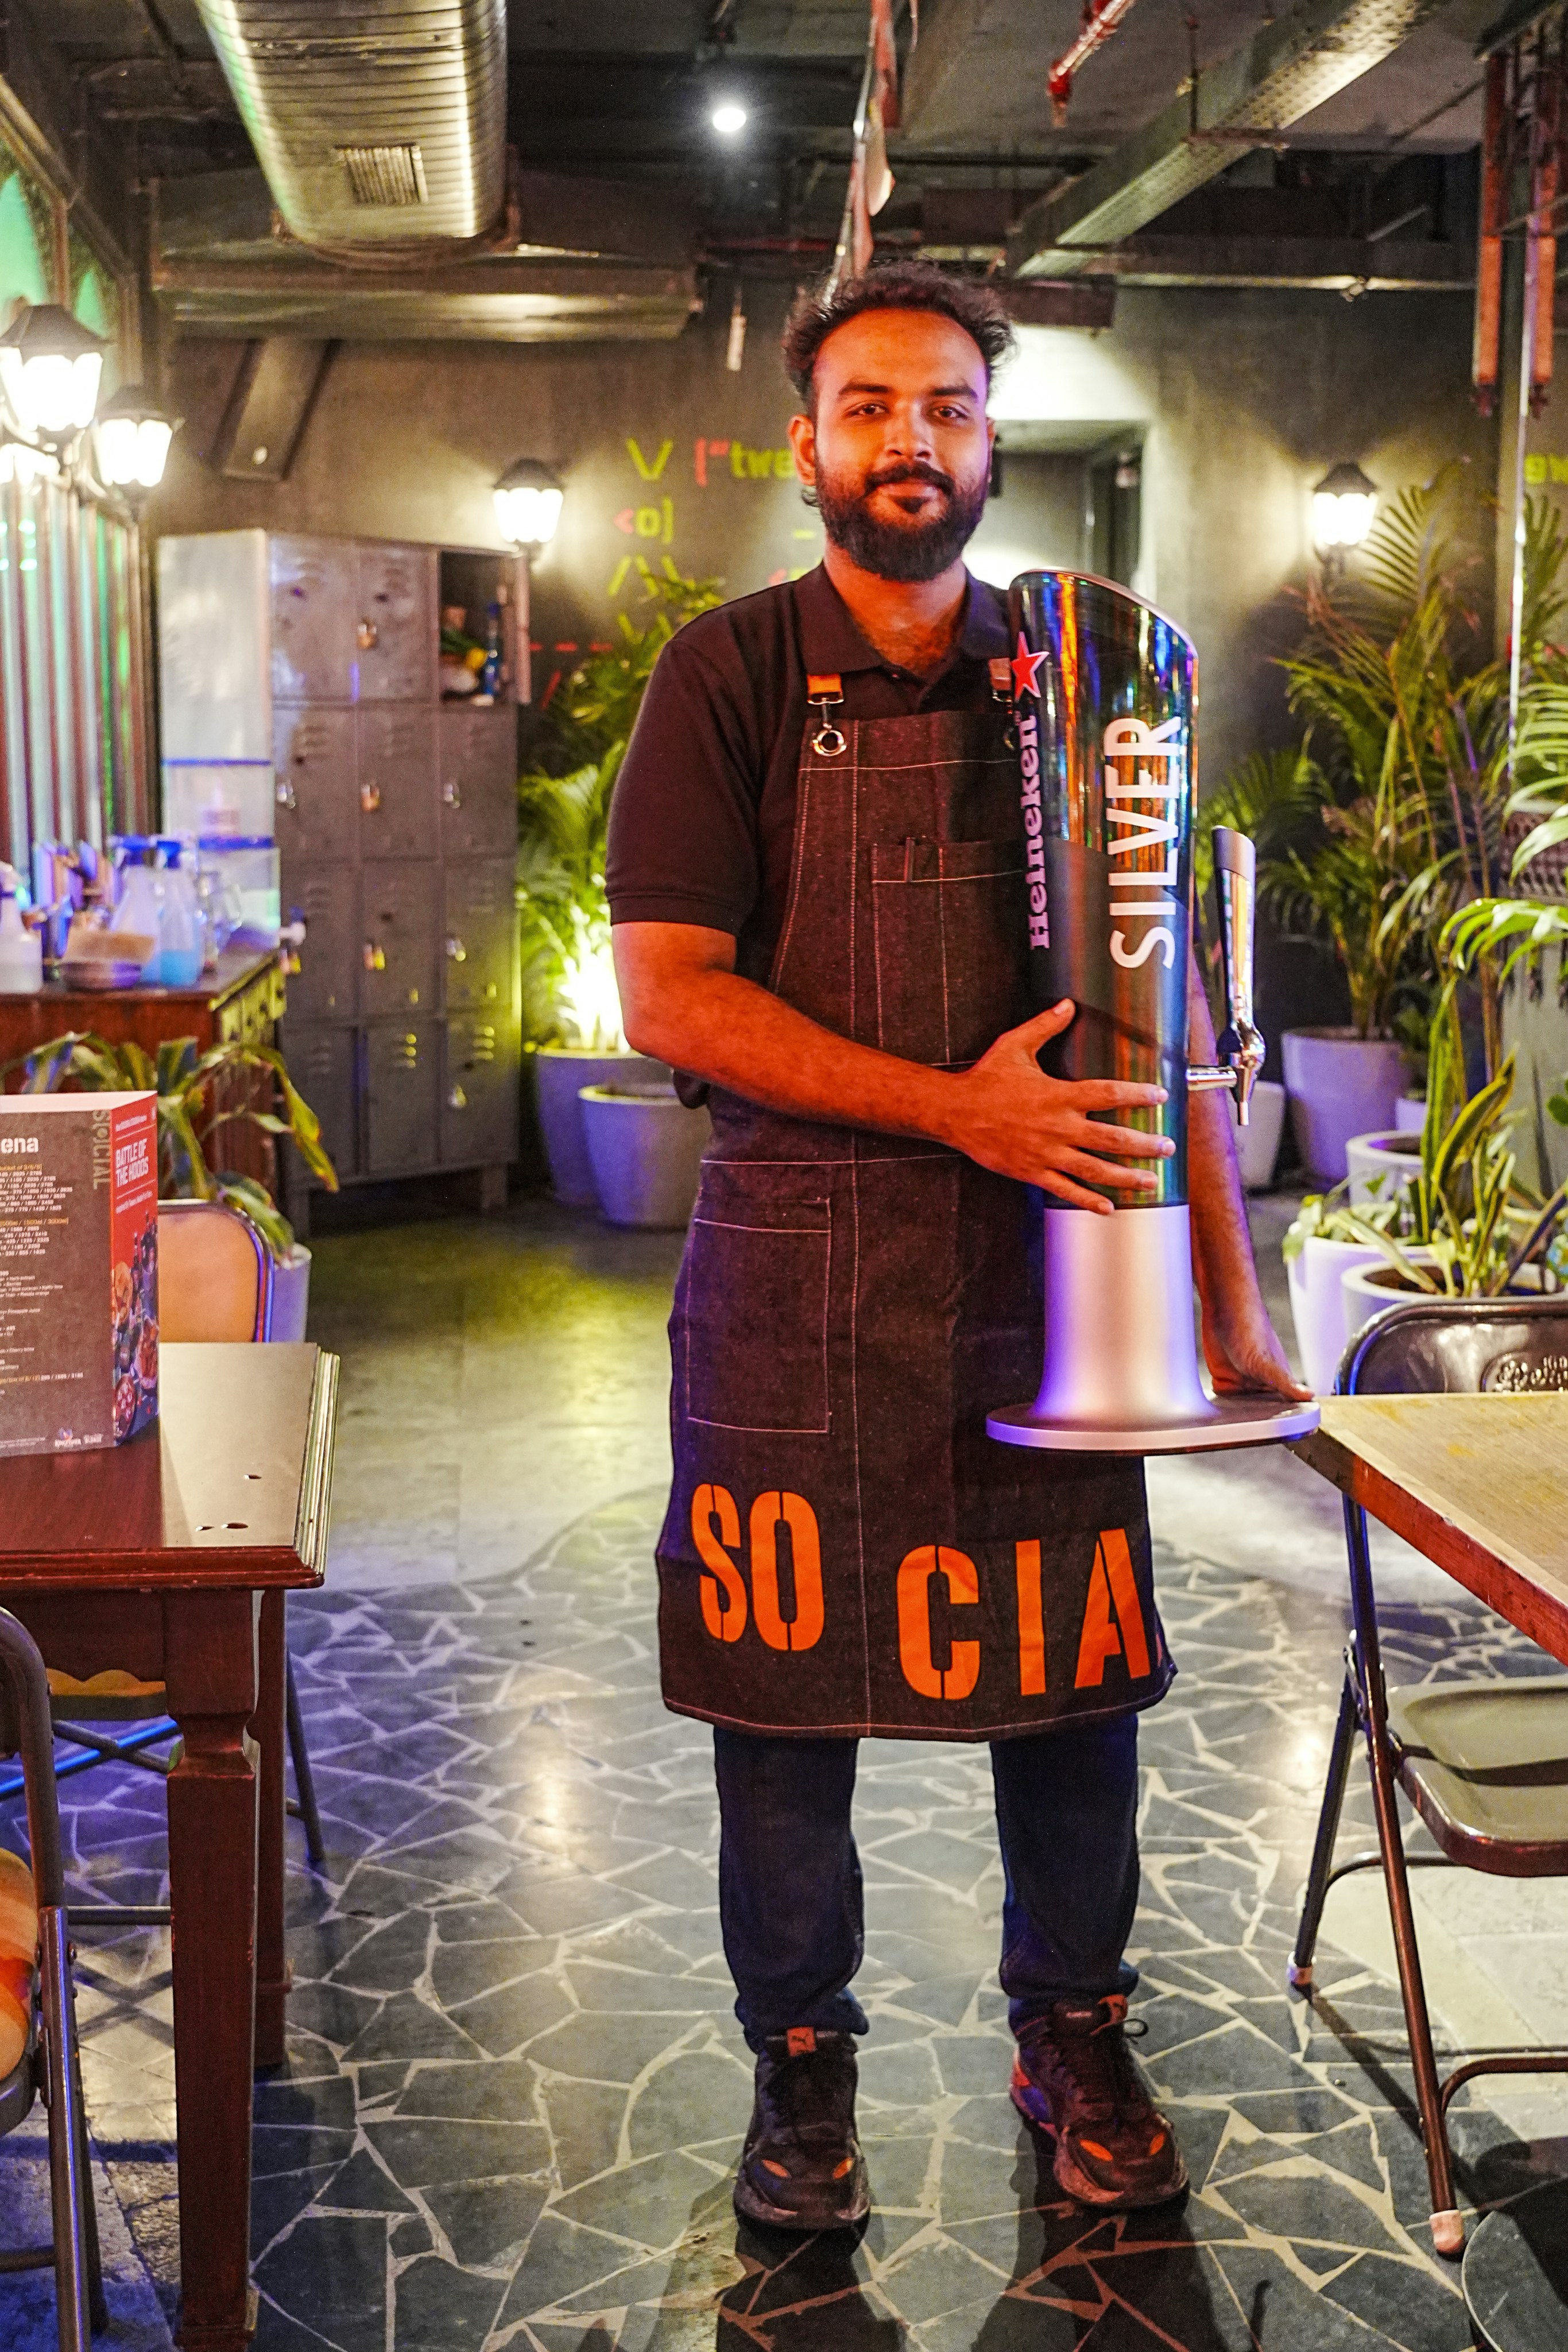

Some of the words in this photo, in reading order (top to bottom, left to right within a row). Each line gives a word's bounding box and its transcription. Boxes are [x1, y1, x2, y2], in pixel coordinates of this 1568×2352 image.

[1019, 715, 1050, 950] Heineken
[1104, 716, 1181, 969] SILVER
[115, 1141, 138, 1169] BATTLE
[138, 1138, 148, 1159] OF
[116, 1165, 129, 1188] THE
[129, 1156, 149, 1182] HOODS
[896, 1528, 1151, 1700] CIA
